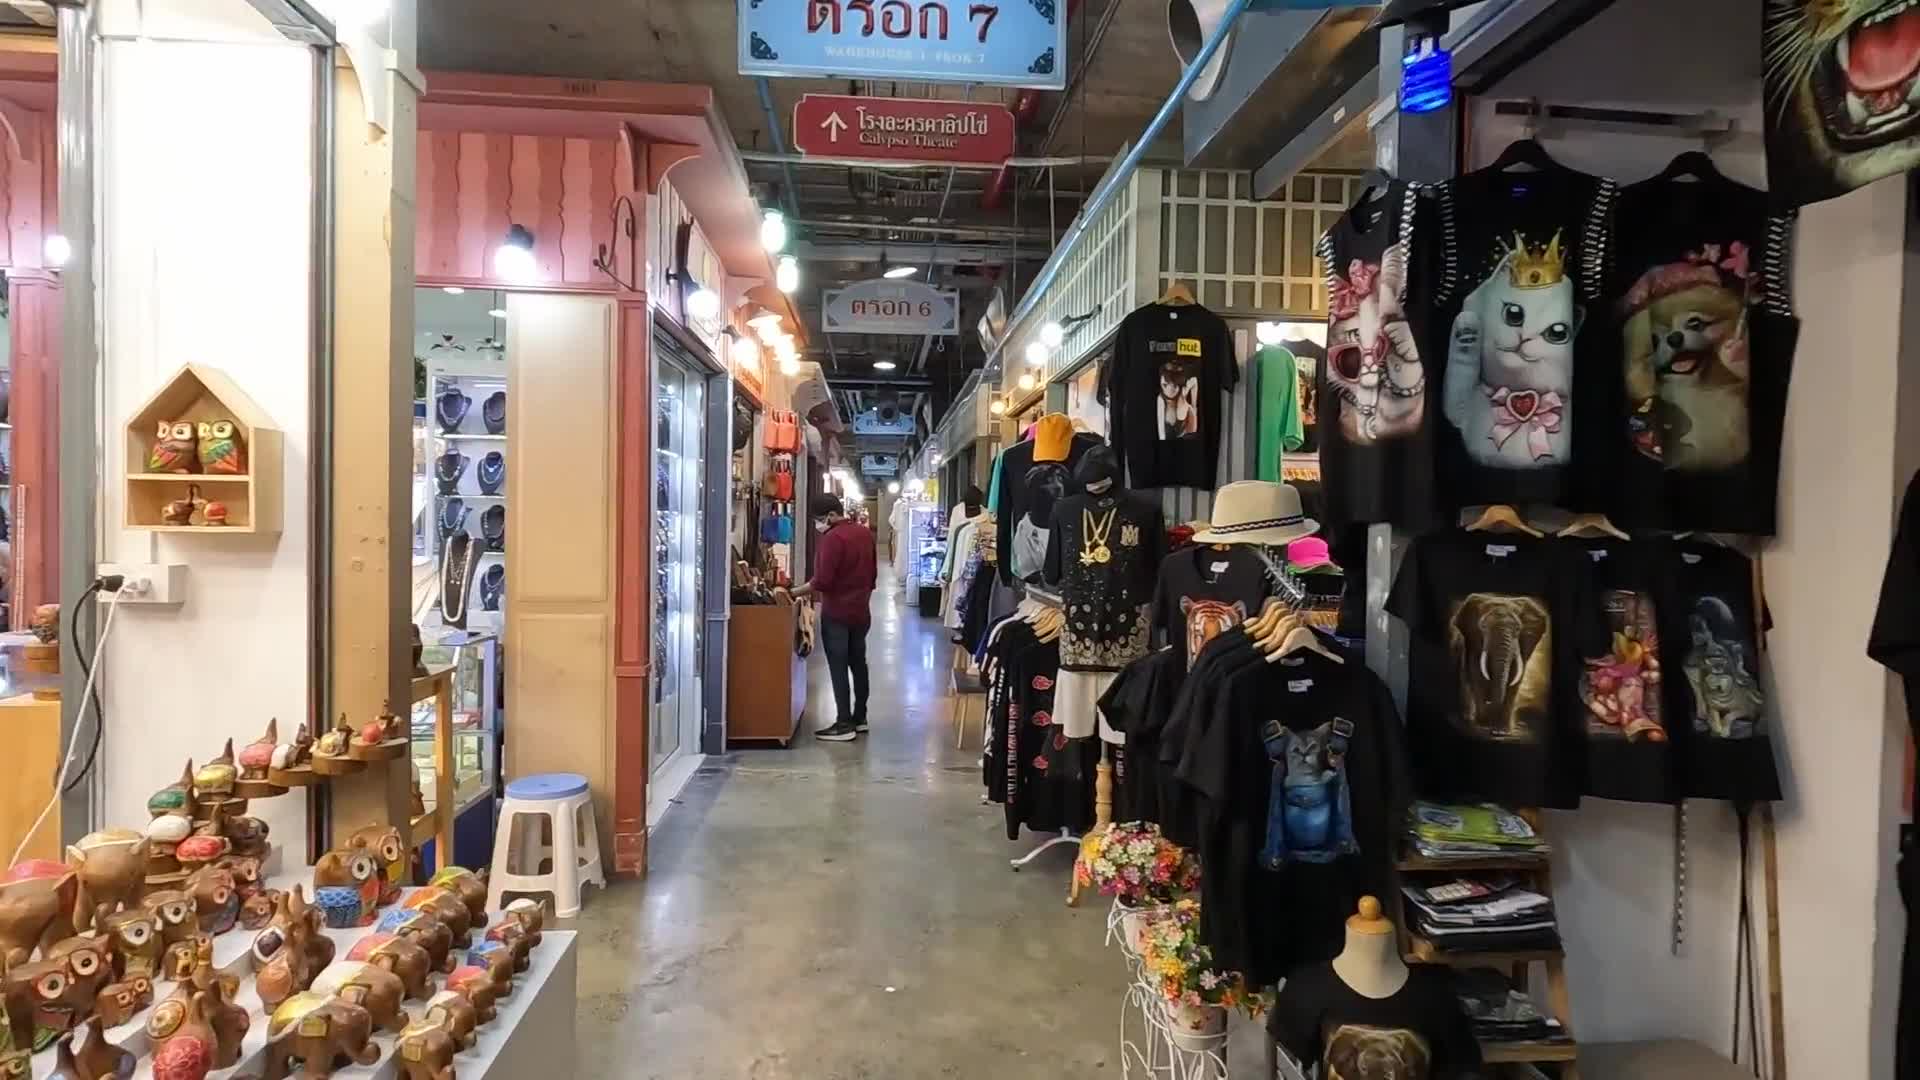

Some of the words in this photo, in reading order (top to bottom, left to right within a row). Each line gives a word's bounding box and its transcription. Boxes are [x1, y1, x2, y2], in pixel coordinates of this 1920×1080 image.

[806, 0, 949, 41] ตรอก
[968, 3, 999, 44] 7
[858, 131, 910, 148] Calypso
[851, 298, 911, 317] ตรอก
[918, 300, 932, 317] 6
